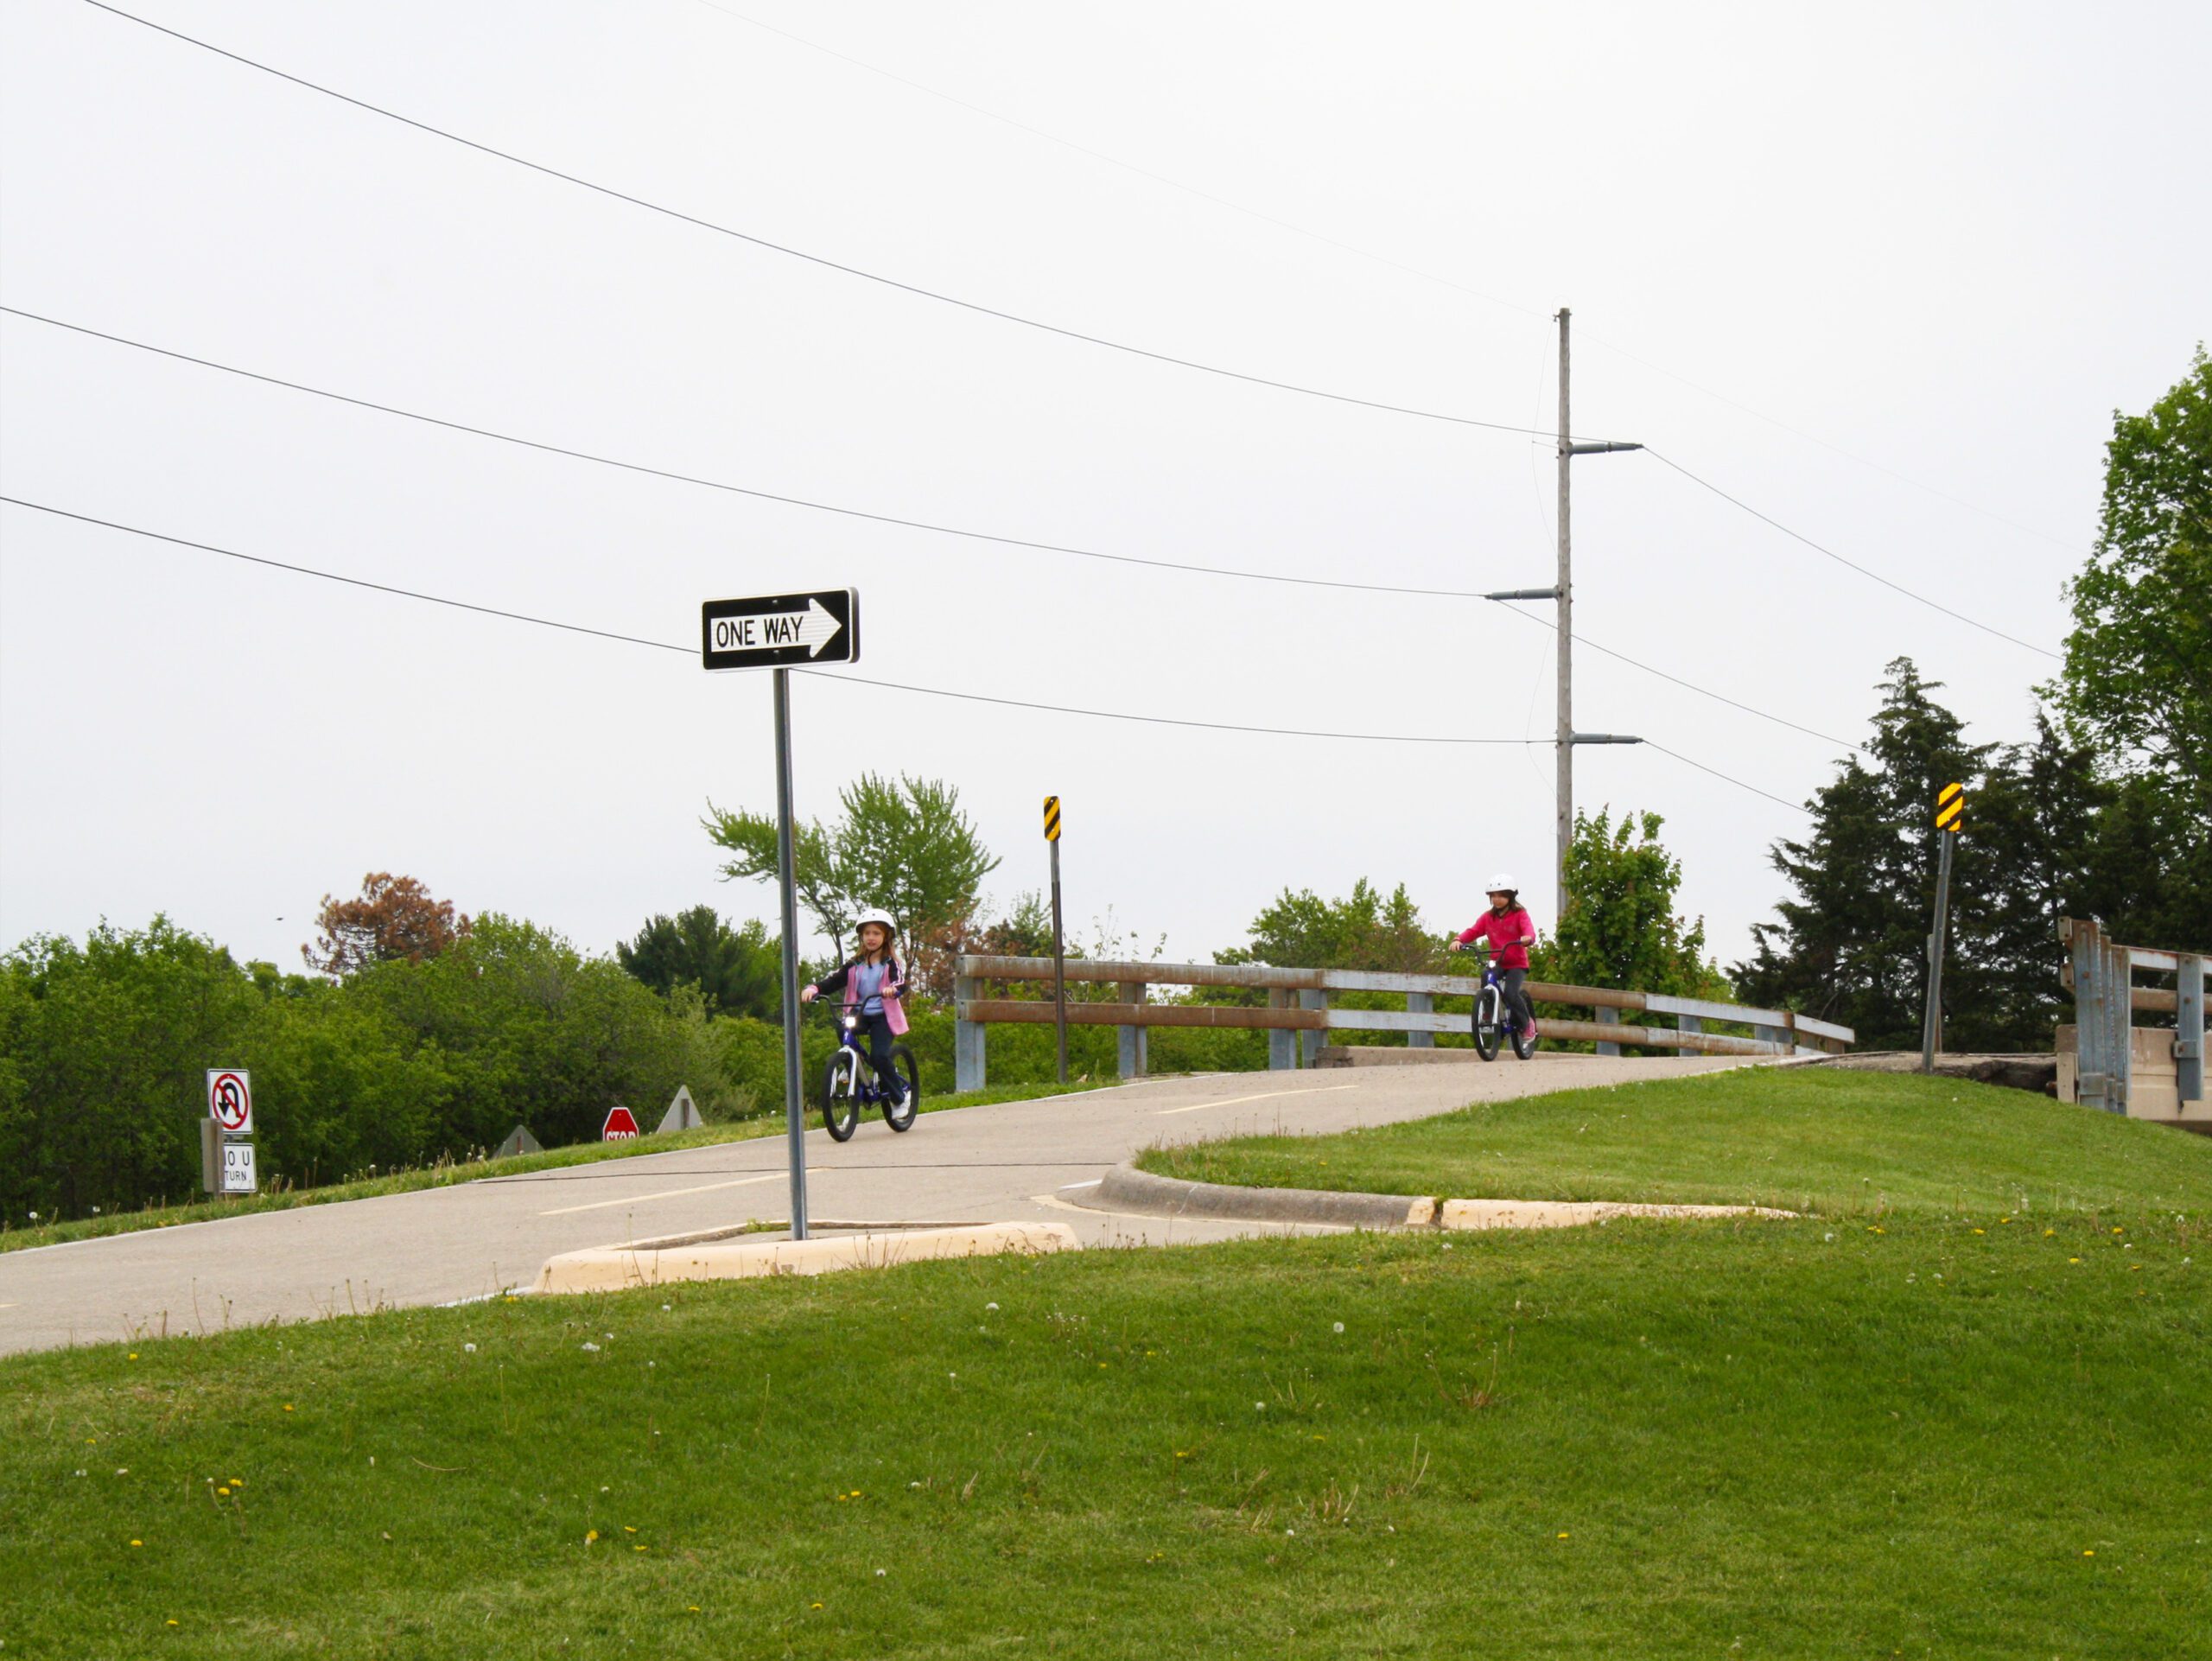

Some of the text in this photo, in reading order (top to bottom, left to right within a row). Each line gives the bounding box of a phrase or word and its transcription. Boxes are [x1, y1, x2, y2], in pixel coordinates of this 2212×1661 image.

[716, 615, 804, 648] ONE WAY
[223, 1150, 251, 1166] O U
[224, 1170, 247, 1181] TURN
